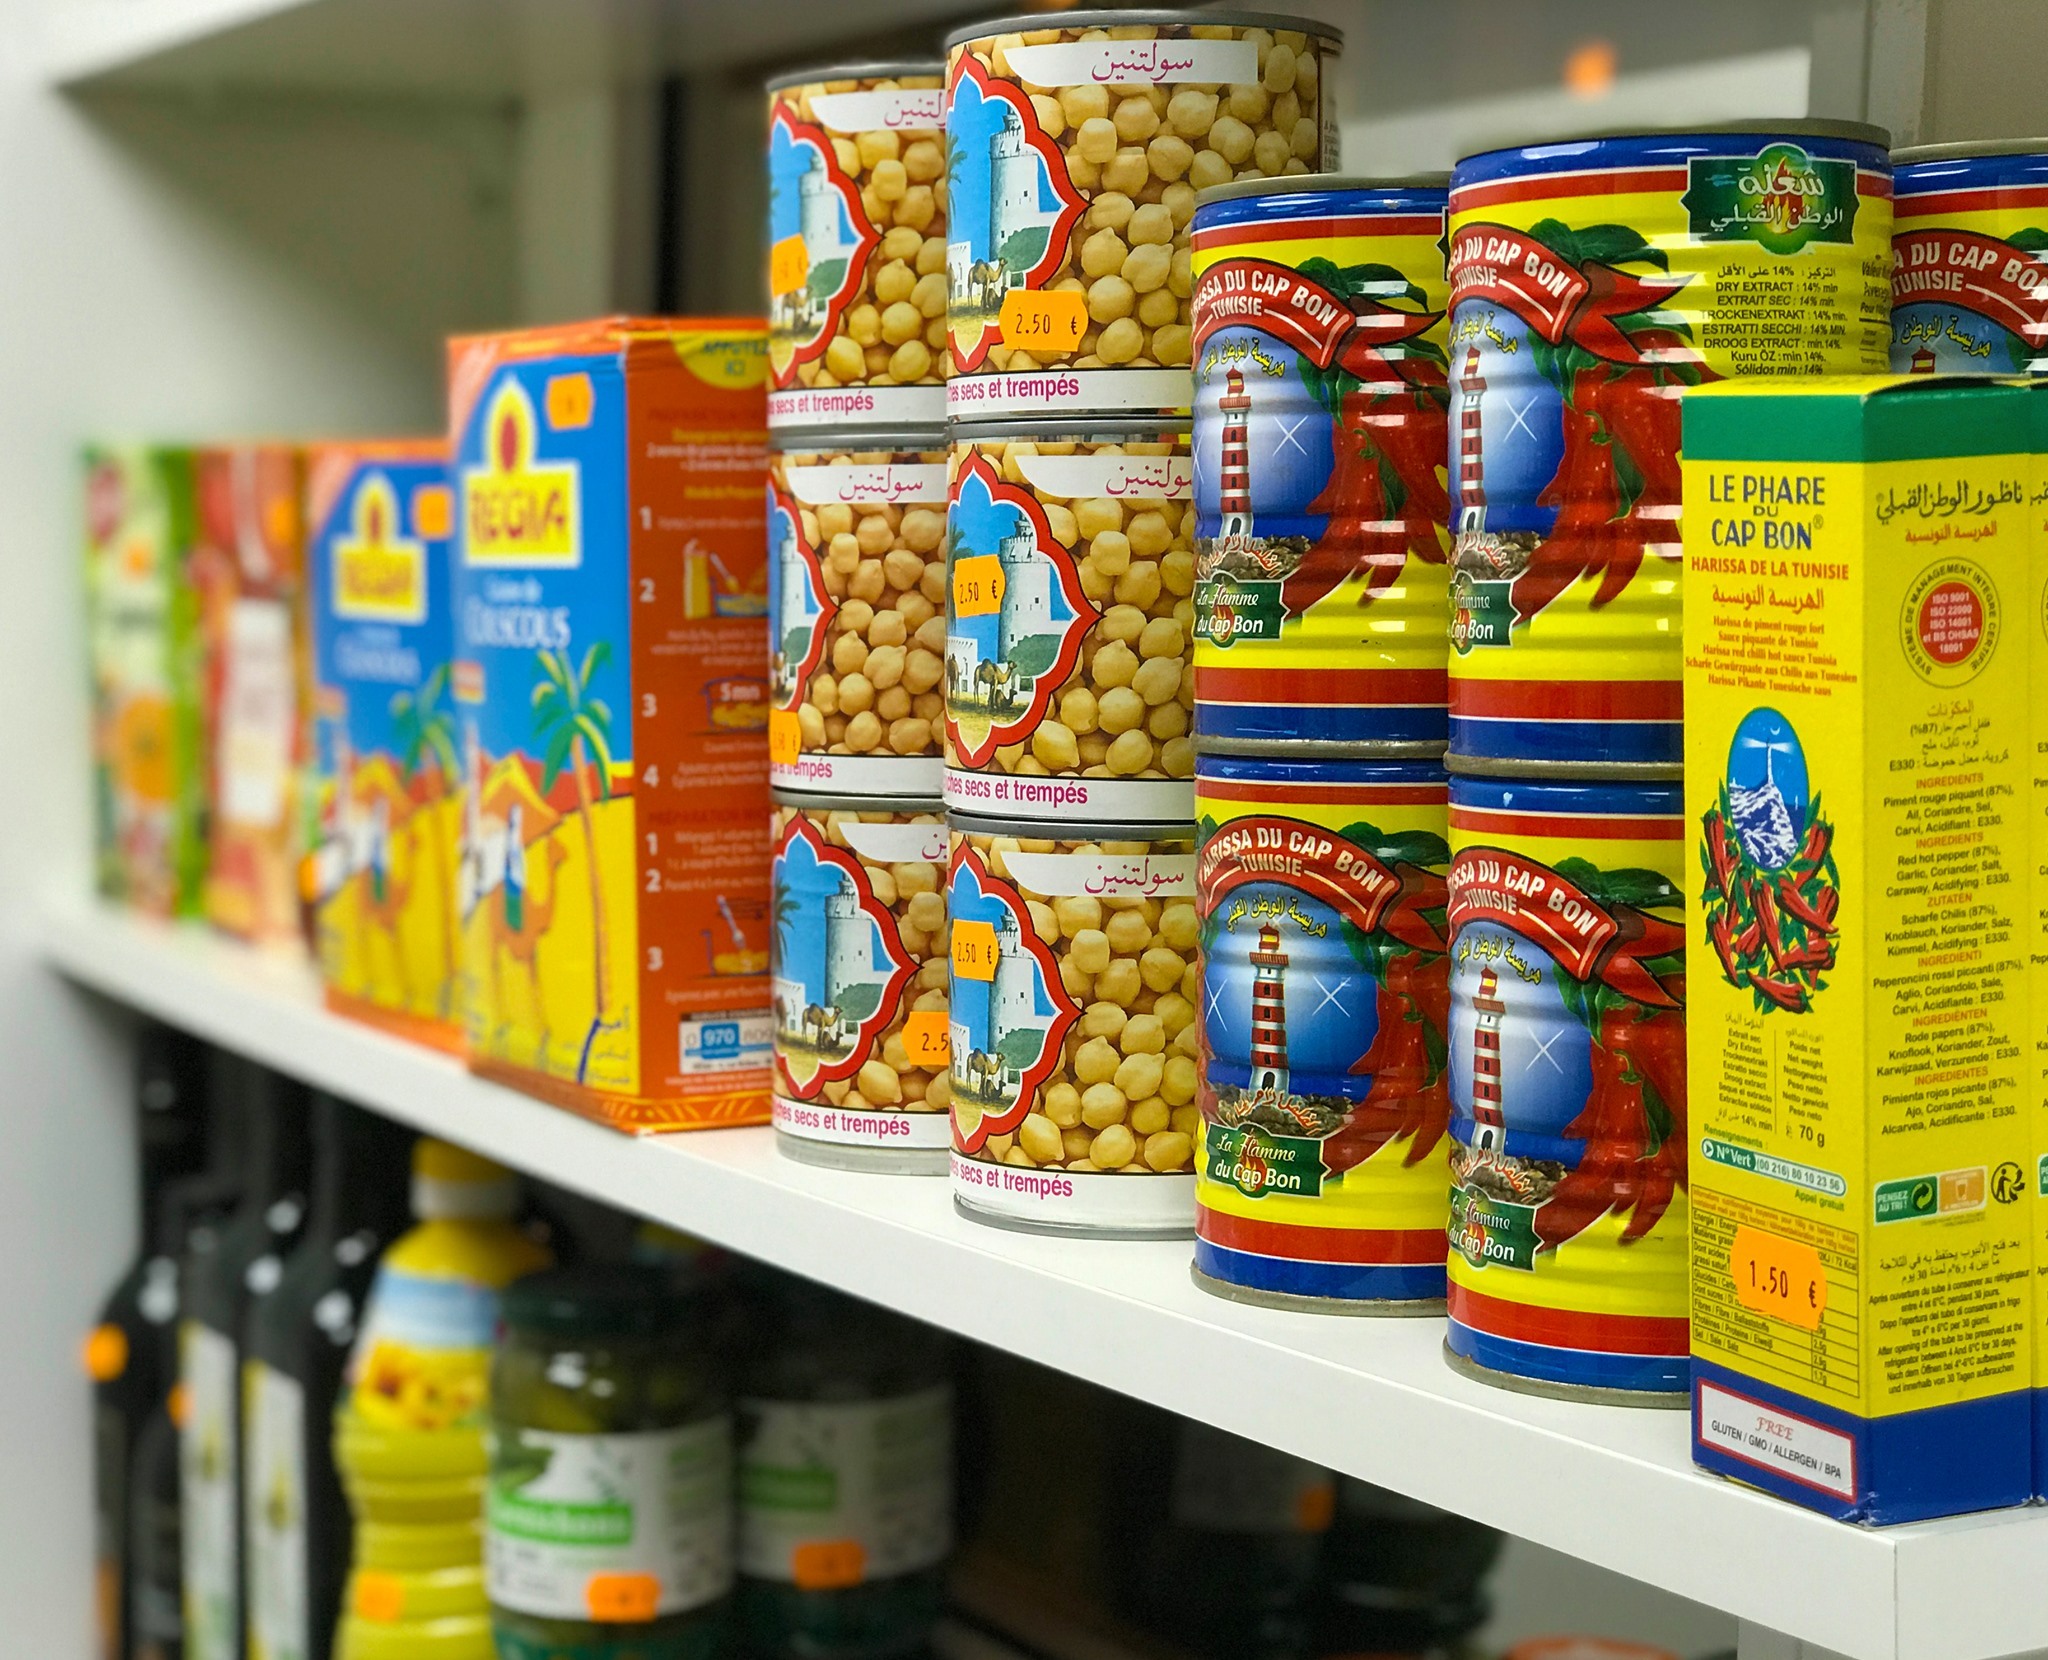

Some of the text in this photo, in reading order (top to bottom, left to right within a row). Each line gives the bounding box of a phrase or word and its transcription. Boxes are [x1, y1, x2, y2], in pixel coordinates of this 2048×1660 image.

[1464, 237, 1571, 298] DU CAP BON
[1911, 242, 1939, 265] DU
[1948, 242, 1998, 271] CAP
[1456, 265, 1497, 292] TUNISIE
[1773, 266, 1794, 276] 14%
[1891, 270, 1964, 296] TUNISIE
[1225, 270, 1338, 327] DU CAP BON
[1716, 282, 1838, 292] DRY EXTRACT 14% min
[1211, 297, 1262, 319] TUNISIE
[1718, 295, 1766, 306] EXTRAIT
[1769, 295, 1790, 306] SEC
[1800, 297, 1817, 306] 14%
[1016, 314, 1050, 334] 2.50
[1813, 311, 1831, 320] 14%
[1702, 324, 1758, 334] ESTRATTI
[1762, 324, 1801, 334] SECCHI
[1810, 324, 1828, 334] 14%
[1704, 338, 1799, 348] DROOG EXTRACT
[1731, 351, 1757, 362] Kuru
[1736, 363, 1774, 375] Sólidos
[1778, 364, 1796, 375] min
[960, 373, 1080, 401] secs et trempés
[799, 396, 808, 412] et
[813, 390, 873, 415] trempés
[1710, 474, 1825, 505] LE PHARE
[1753, 505, 1778, 517] DU
[1712, 518, 1756, 547] CAP
[1692, 556, 1849, 581] HARISSA DE LA TUNISIE
[640, 579, 655, 603] 2
[960, 582, 978, 604] 2.50
[1209, 583, 1259, 608] Flamme
[1197, 615, 1263, 636] du Cap Bon
[1714, 616, 1741, 627] Harissa
[1743, 618, 1752, 628] de
[1784, 624, 1806, 635] rouge
[643, 765, 658, 788] 4
[1916, 773, 1984, 789] INGREDIENTS
[965, 780, 1087, 808] secs et trempés
[1883, 795, 1917, 807] Piment
[1919, 792, 1946, 804] rouge
[1949, 788, 1983, 802] piquant
[1203, 828, 1384, 893] HARISSA DU CAP BON
[1241, 853, 1302, 877] TUNISIE
[1898, 850, 1969, 866] Red hot pepper
[1466, 888, 1517, 915] TUNISIE
[1479, 860, 1599, 937] DU CAP BON
[1927, 893, 1972, 907] ZUTATEN
[958, 942, 976, 962] 2.50
[795, 1109, 910, 1139] secs et trempés
[1799, 1124, 1824, 1148] 70 g
[1216, 1133, 1295, 1161] La Flamme
[1731, 1150, 1751, 1168] Vert
[960, 1163, 1073, 1200] secs et trempés
[1215, 1160, 1300, 1189] du Cap Bon
[1792, 1168, 1802, 1180] 80
[1804, 1171, 1814, 1184] 10
[1817, 1175, 1827, 1187] 23
[1829, 1178, 1840, 1191] 56
[1795, 1189, 1817, 1203] Appel
[1483, 1237, 1515, 1261] Bon
[1750, 1260, 1788, 1298] 1.50
[1755, 1416, 1794, 1441] FREE
[1711, 1419, 1842, 1480] GLUTEN GMO ALLERGEN BPA
